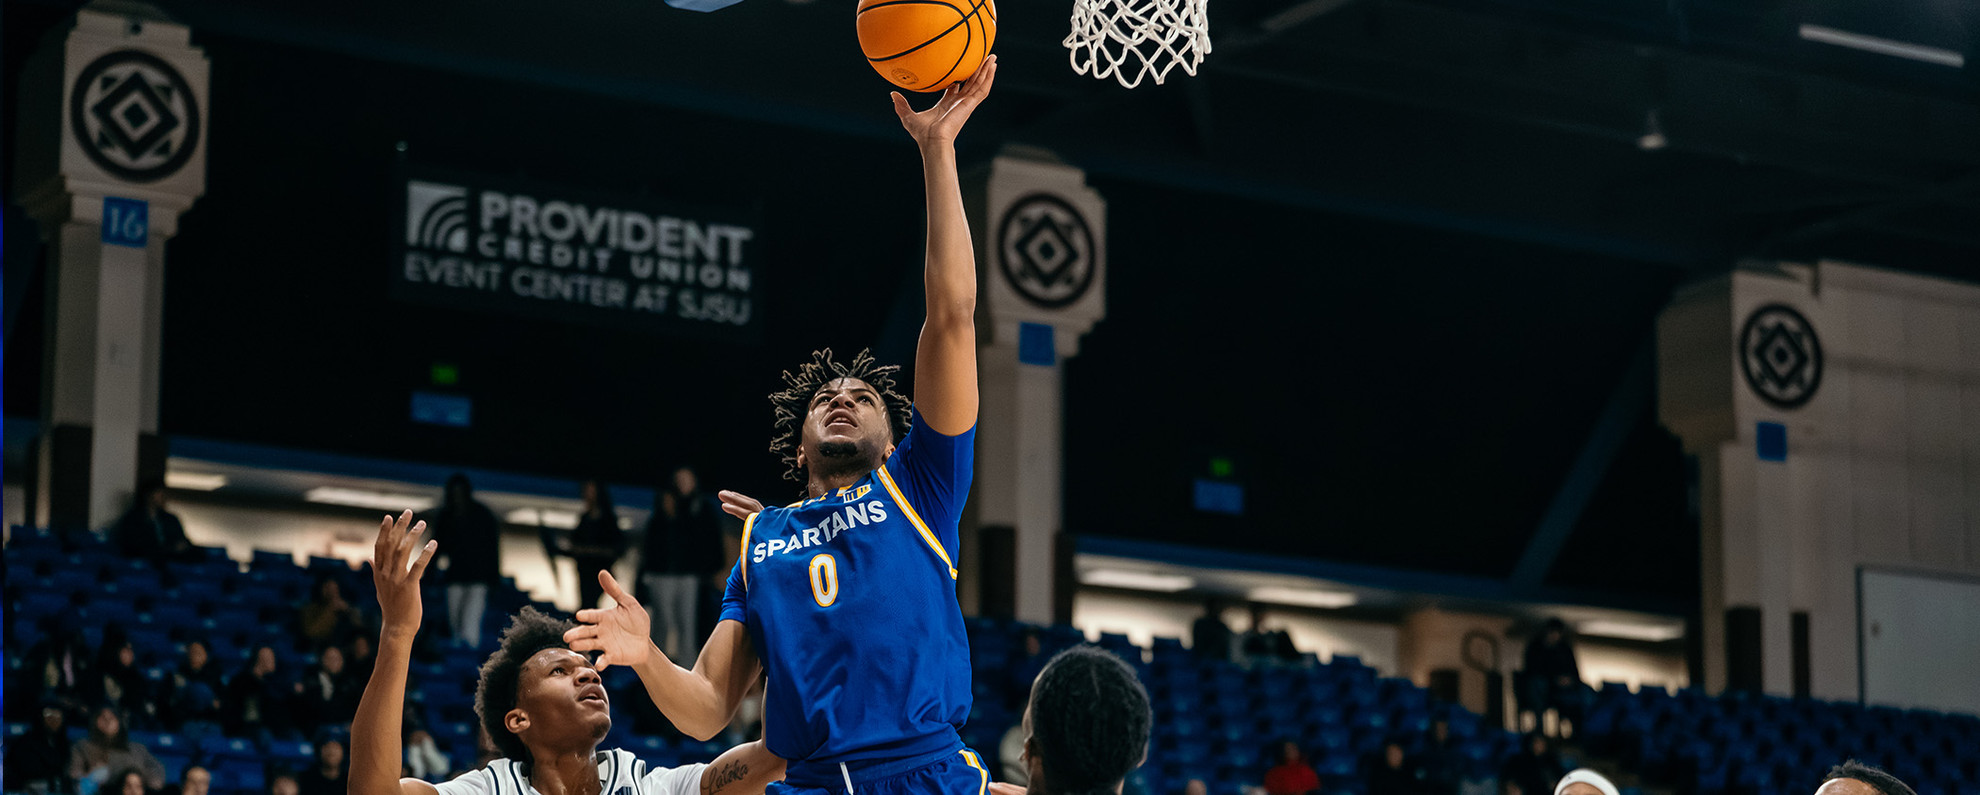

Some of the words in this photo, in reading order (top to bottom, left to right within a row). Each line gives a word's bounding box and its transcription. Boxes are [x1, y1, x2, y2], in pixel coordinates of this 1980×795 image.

[111, 208, 144, 240] 16
[480, 191, 752, 266] PROVIDENT
[404, 251, 502, 292] EVENT
[511, 266, 628, 308] CENTER
[633, 284, 670, 314] AT
[677, 289, 750, 325] SJSU
[477, 232, 611, 273] CREDIT
[630, 254, 750, 291] UNION
[753, 500, 888, 563] SPARTANS
[808, 553, 839, 607] 0
